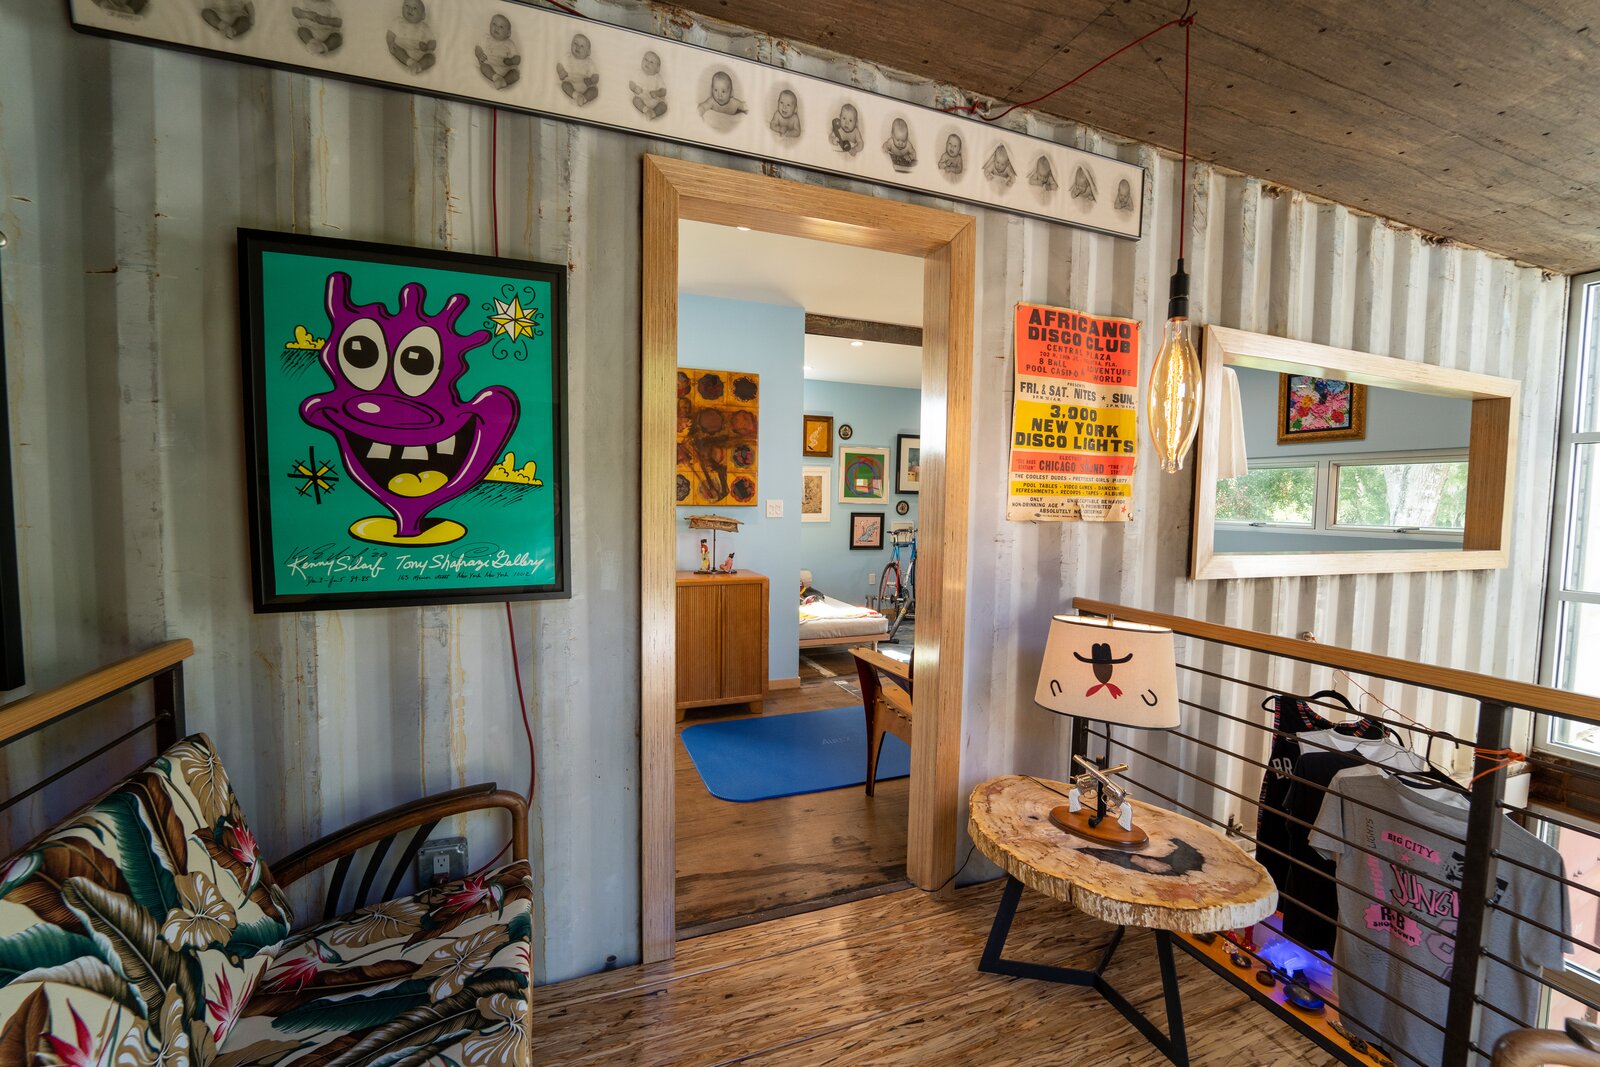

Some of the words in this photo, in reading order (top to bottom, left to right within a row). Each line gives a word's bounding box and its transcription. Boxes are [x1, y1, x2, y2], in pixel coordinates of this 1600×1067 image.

[1029, 309, 1131, 339] AFRICANO
[1028, 326, 1081, 346] DISCO
[1086, 336, 1130, 353] CLUB
[1047, 344, 1082, 356] CENTRAL
[1086, 351, 1111, 361] PLAZA
[1026, 364, 1047, 373] POOL
[1051, 367, 1078, 377] CASINO
[1087, 365, 1131, 377] ADVENTURE
[1047, 359, 1067, 368] BALL
[1094, 375, 1122, 383] WORLD
[1020, 382, 1039, 395] FRI.
[1041, 384, 1046, 395] &
[1049, 385, 1069, 398] SAT.
[1074, 388, 1096, 401] NITES
[1112, 393, 1135, 405] SUN.
[1050, 405, 1097, 422] 3,000
[1032, 418, 1068, 434] NEW
[1075, 422, 1119, 438] YORK
[1015, 432, 1067, 448] DISCO
[1074, 436, 1134, 453] LIGHTS
[1039, 460, 1076, 472] CHICAGO
[1080, 463, 1105, 475] SOUND
[287, 555, 335, 580] Kenny
[396, 555, 428, 576] Tony
[428, 553, 492, 572] Shafrazi
[492, 550, 545, 574] Gallery
[1366, 818, 1377, 849] LIGHTS
[1387, 833, 1404, 845] BIG
[1404, 839, 1435, 858] CITY
